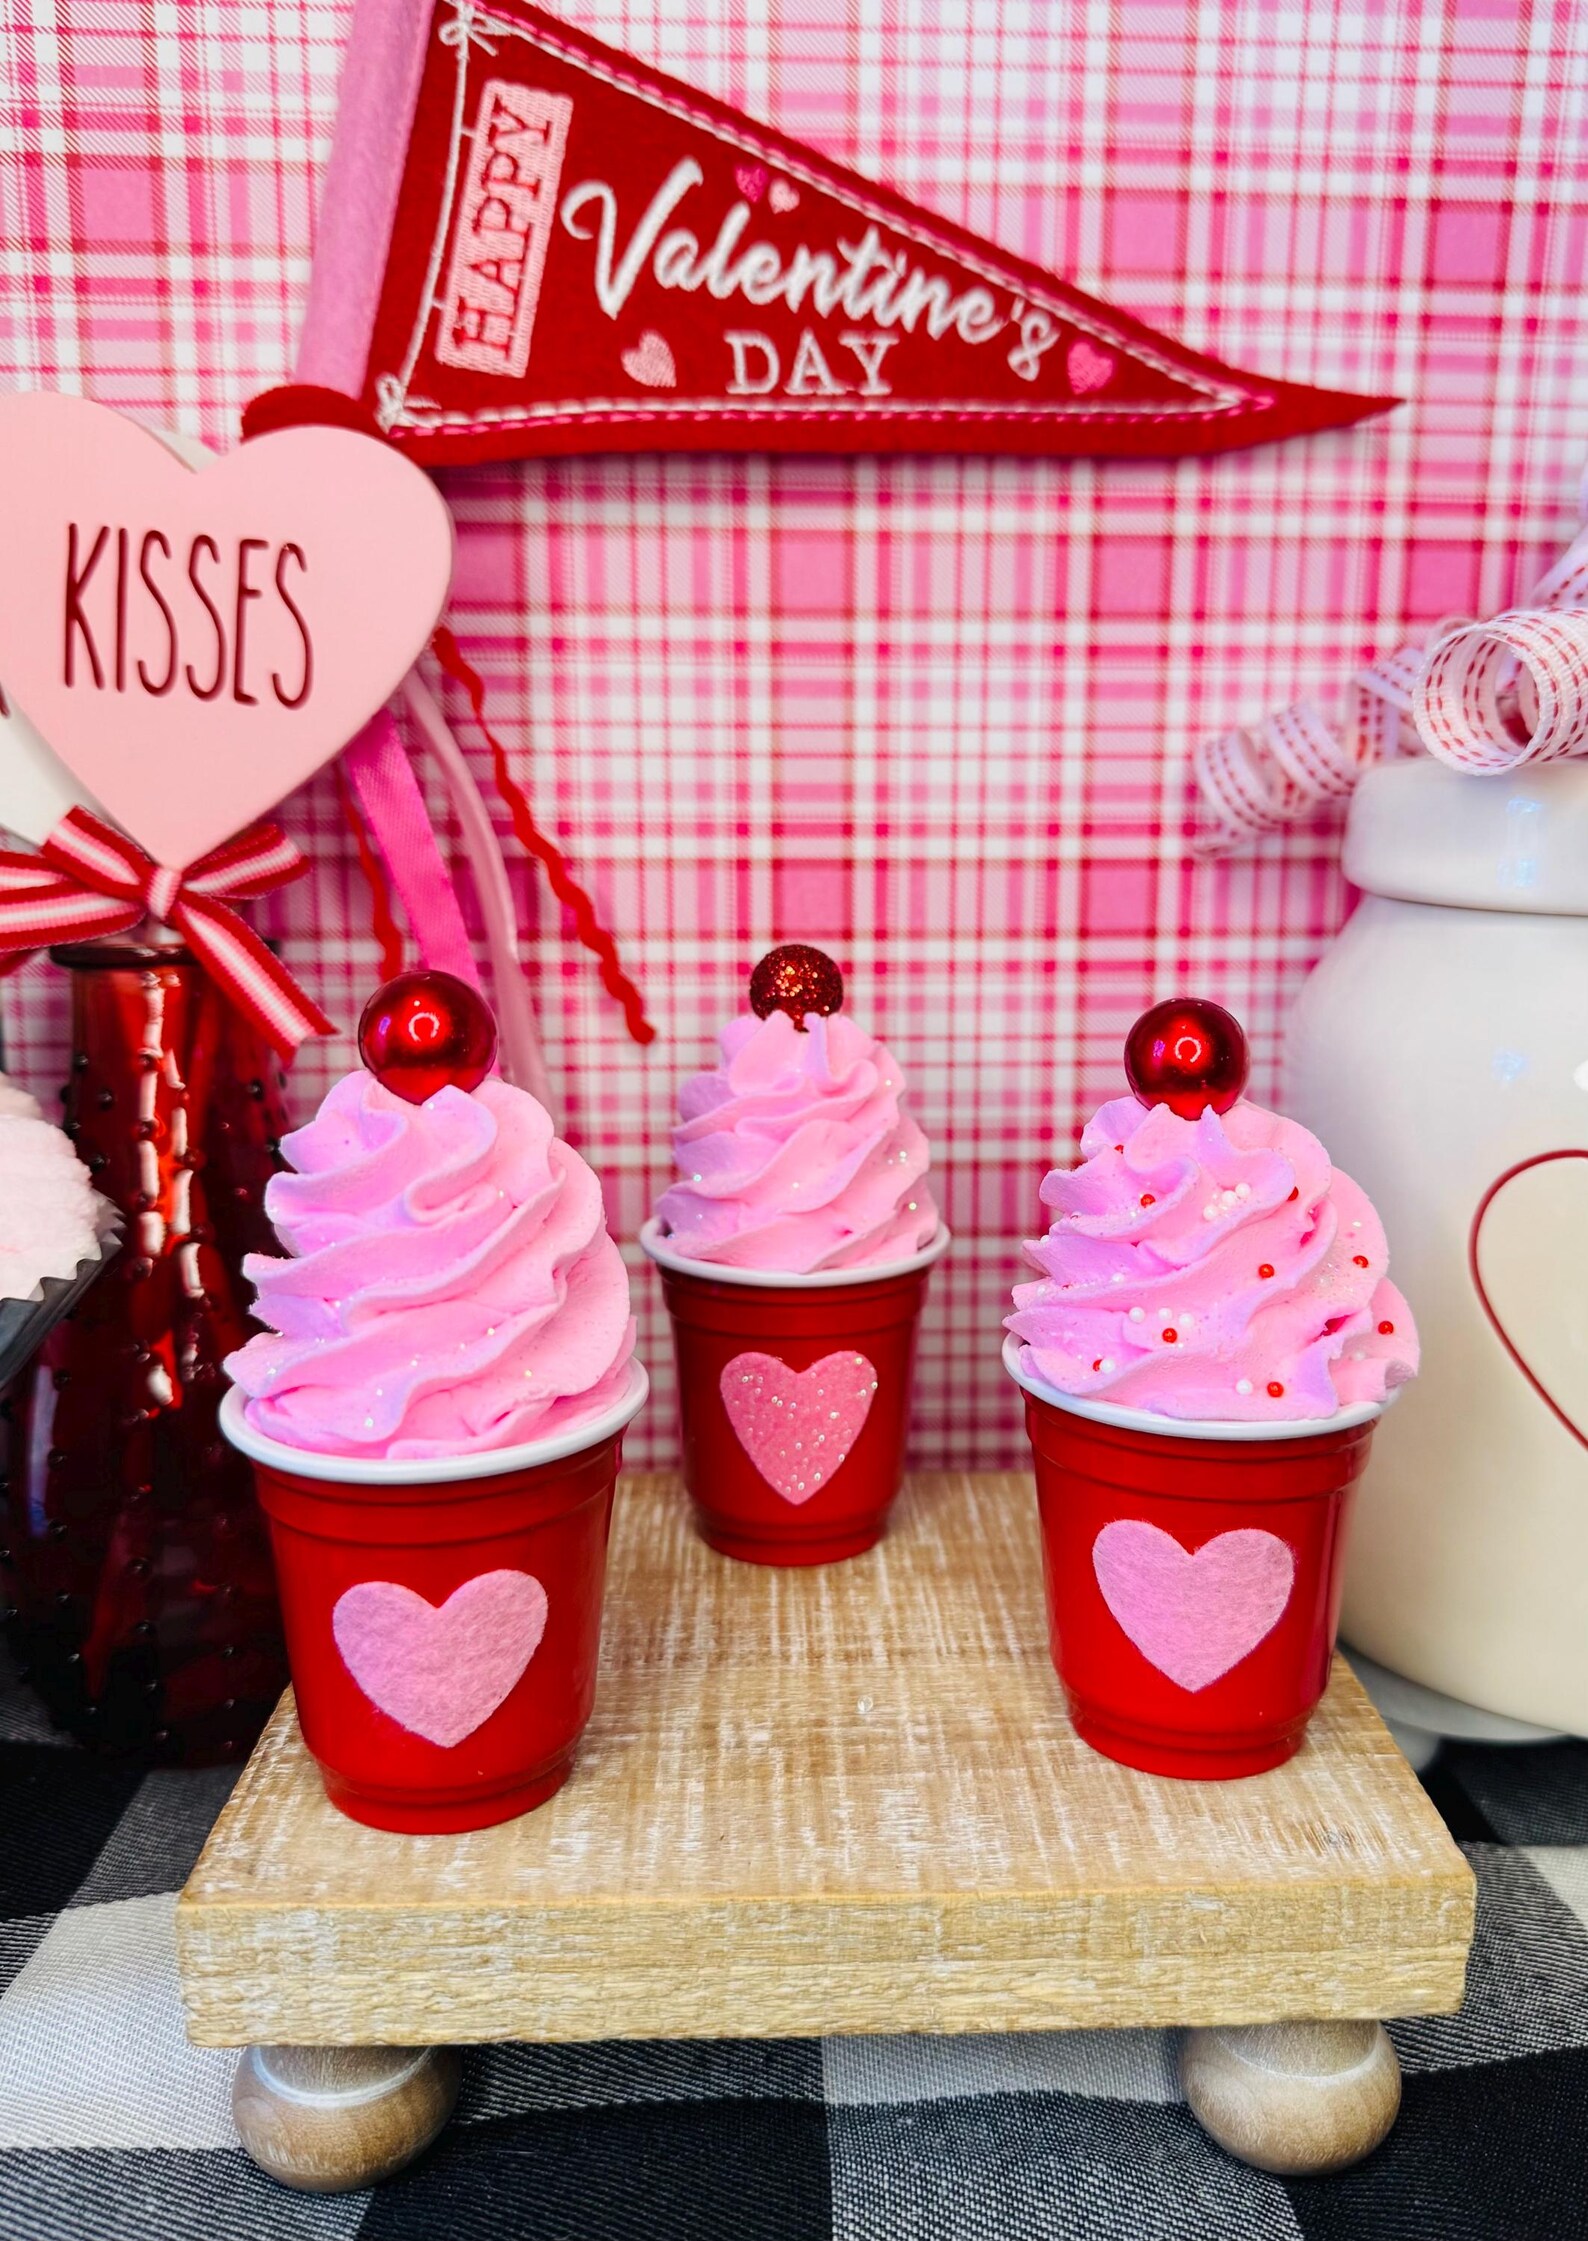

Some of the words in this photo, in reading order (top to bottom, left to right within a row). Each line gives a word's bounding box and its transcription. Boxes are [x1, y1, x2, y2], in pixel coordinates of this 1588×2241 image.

[452, 95, 552, 359] HAPPY
[561, 157, 1060, 382] Valentine's
[723, 330, 900, 397] DAY
[63, 522, 314, 711] KISSES
